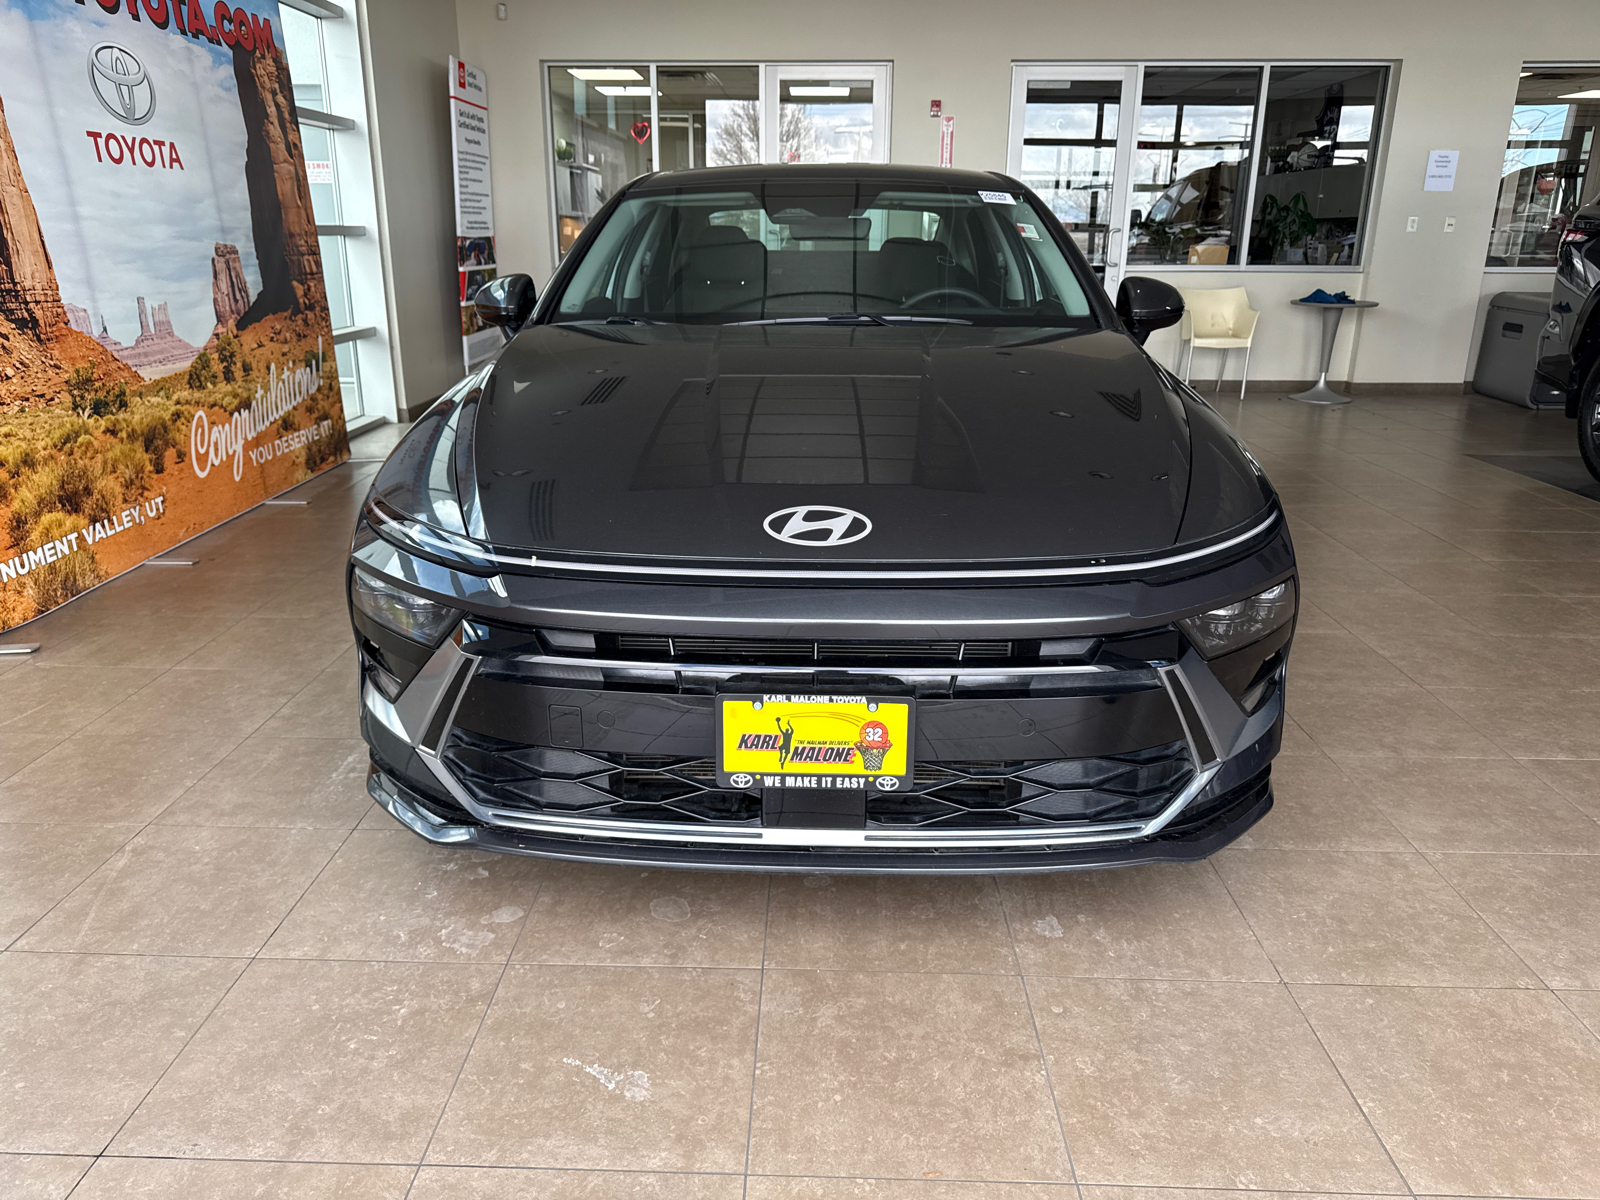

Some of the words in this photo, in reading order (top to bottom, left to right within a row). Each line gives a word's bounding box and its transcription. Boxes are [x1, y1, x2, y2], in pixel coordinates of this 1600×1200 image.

[86, 130, 184, 170] TOYOTA
[191, 335, 323, 482] Congratulations!
[249, 446, 273, 466] YOU
[274, 424, 319, 456] DESERVE
[320, 419, 333, 437] IT!
[0, 532, 78, 583] NUMENT
[82, 506, 145, 545] VALLEY,
[145, 496, 164, 518] UT
[763, 695, 789, 703] KARL
[790, 695, 829, 704] MALONE
[832, 696, 867, 704] TOYOTA
[736, 733, 781, 751] KARL
[865, 728, 883, 742] 32
[789, 746, 857, 764] MALONE
[764, 776, 781, 787] WE
[785, 776, 818, 788] MAKE
[822, 777, 833, 788] IT
[836, 777, 865, 789] EASY
